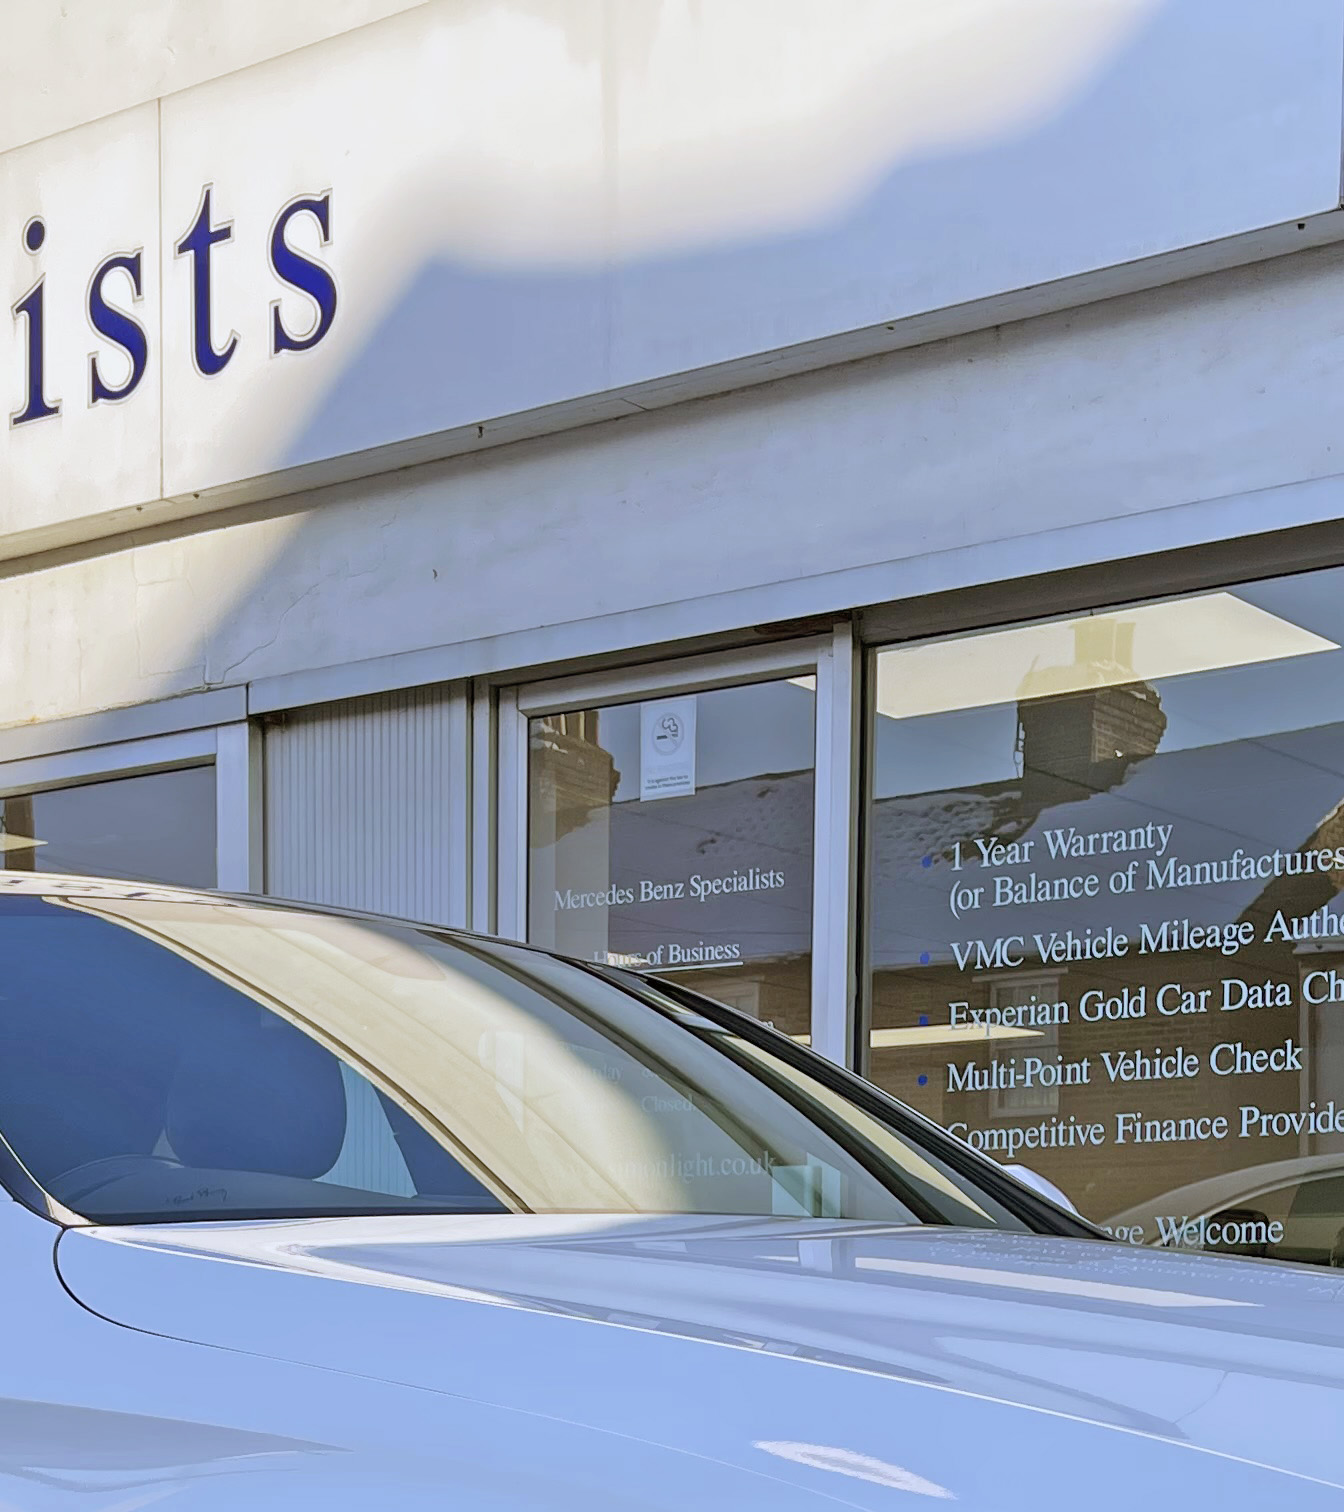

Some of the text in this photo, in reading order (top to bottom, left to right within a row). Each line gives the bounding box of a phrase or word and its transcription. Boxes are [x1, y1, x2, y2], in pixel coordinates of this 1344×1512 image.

[951, 823, 1173, 871] 1 Year Warranty
[554, 868, 784, 910] Mercedes Benz Specialists
[950, 883, 985, 918] (or
[993, 874, 1100, 907] Balance
[1109, 861, 1138, 894] of
[647, 944, 664, 965] of
[668, 941, 740, 963] Business
[950, 936, 1024, 971] VMC
[1033, 928, 1129, 964] Vehicle
[1139, 918, 1254, 956] Mileage
[948, 996, 1070, 1036] Experian
[1079, 986, 1146, 1024] Gold
[1156, 983, 1210, 1017] Car
[1221, 978, 1292, 1011] Data
[947, 1039, 1302, 1093] Multi-Point Vehicle Check
[1115, 1112, 1228, 1145] Finance
[1155, 1215, 1284, 1247] Welcome
